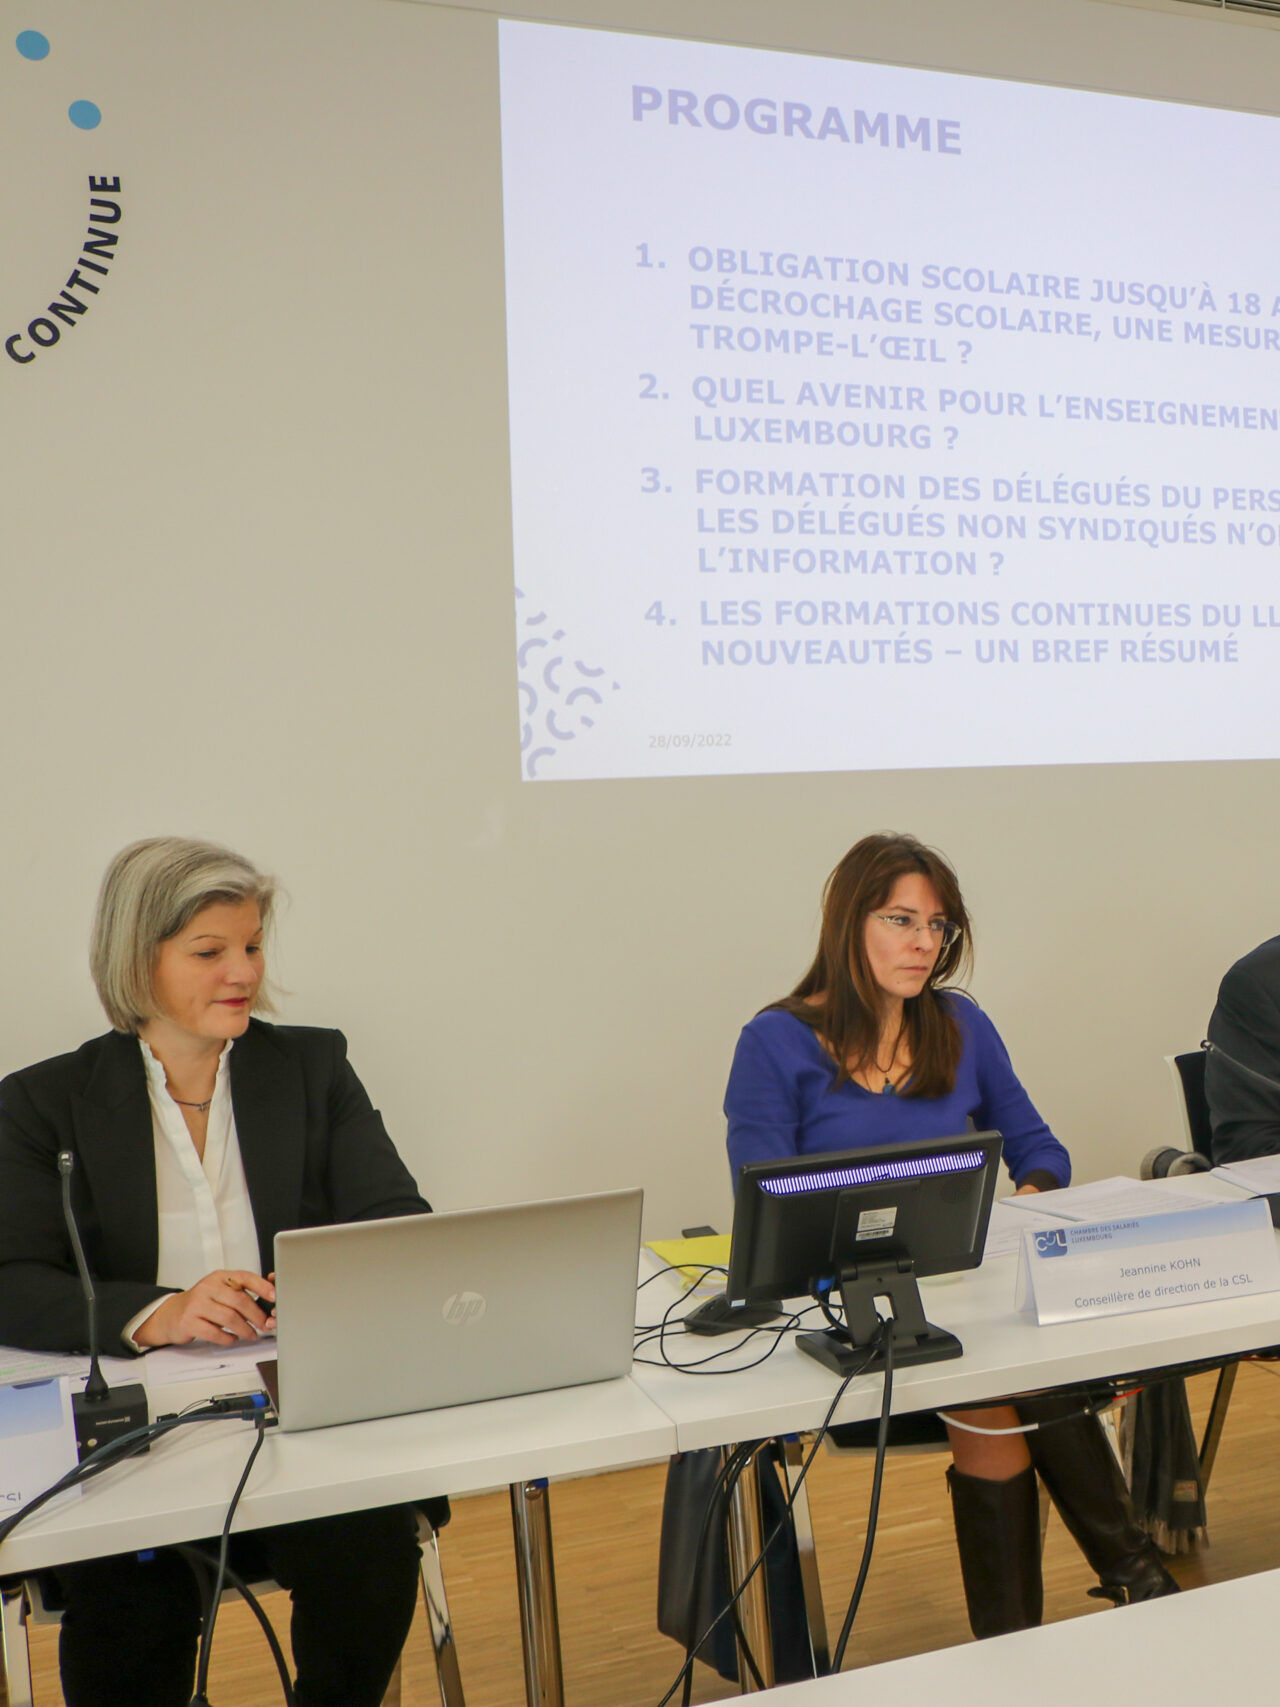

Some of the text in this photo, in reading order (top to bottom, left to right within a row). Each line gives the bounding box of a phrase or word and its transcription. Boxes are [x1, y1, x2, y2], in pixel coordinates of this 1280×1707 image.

[631, 85, 962, 155] PROGRAMME
[5, 175, 122, 365] CONTINUE
[635, 243, 666, 269] 1.
[688, 246, 909, 286] OBLIGATION
[921, 264, 1080, 300] SCOLAIRE
[1228, 292, 1261, 315] 18
[689, 278, 923, 324] DÉCROCHAGE
[934, 301, 1101, 341] SCOLAIRE,
[1112, 315, 1173, 343] UNE
[957, 340, 973, 365] ?
[638, 373, 670, 401] 2.
[692, 375, 784, 409] QUEL
[796, 381, 927, 412] AVENIR
[939, 389, 1027, 417] POUR
[694, 415, 959, 450] LUXEMBOURG ?
[640, 467, 672, 494] 3.
[695, 468, 905, 498] FORMATION
[919, 476, 980, 501] DES
[992, 472, 1150, 507] DÉLÉGUÉS
[1161, 485, 1201, 509] DU
[696, 508, 759, 534] LES
[772, 503, 946, 538] DÉLÉGUÉS
[957, 514, 1026, 539] NON
[1038, 513, 1217, 549] SYNDIQUÉS
[699, 547, 1005, 576] L’INFORMATION ?
[644, 601, 677, 626] 4.
[700, 600, 762, 626] LES
[775, 600, 1000, 626] FORMATIONS
[1010, 602, 1191, 628] CONTINUES
[1202, 604, 1241, 628] DU
[701, 631, 933, 666] NOUVEAUTÉS
[975, 639, 1020, 664] UN
[1032, 639, 1109, 663] BREF
[1121, 632, 1239, 663] RÉSUMÉ
[648, 733, 732, 750] 28/09/2022
[1071, 1227, 1098, 1236] CHAMBRE
[1071, 1233, 1112, 1243] LUXEMBOURG
[1119, 1258, 1201, 1278] Jeannine KOHN
[1075, 1274, 1253, 1308] Conseillère de direction de la CSL
